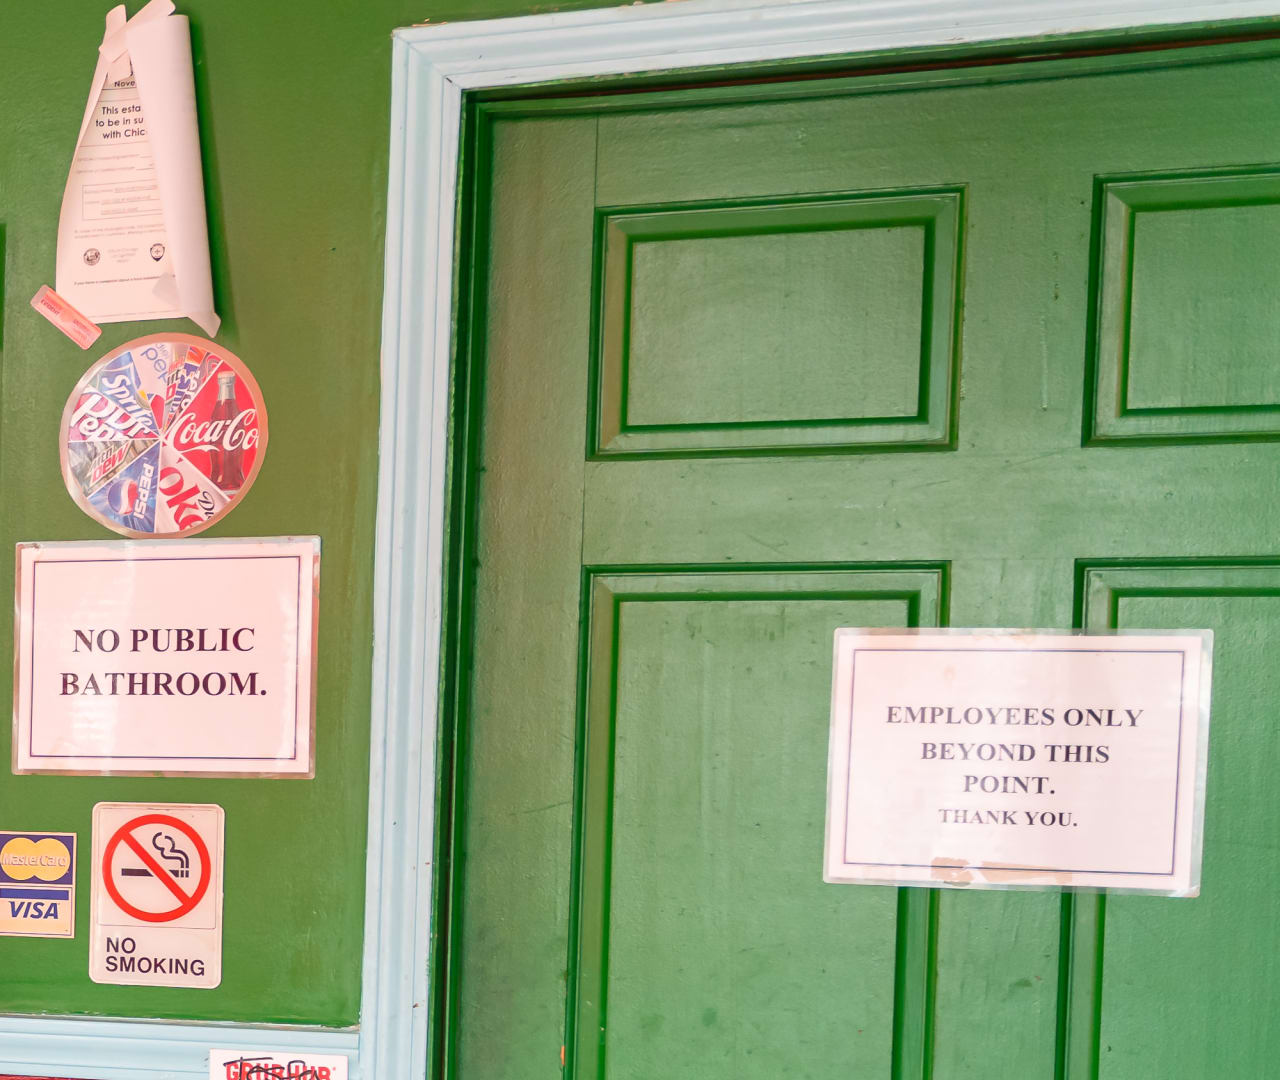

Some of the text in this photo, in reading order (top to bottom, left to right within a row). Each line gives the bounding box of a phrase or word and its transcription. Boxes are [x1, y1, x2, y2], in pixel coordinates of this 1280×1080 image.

[102, 107, 118, 115] This
[96, 119, 105, 127] to
[123, 117, 130, 125] in
[103, 128, 148, 139] with Chic
[102, 375, 155, 431] Sprite
[165, 409, 259, 454] Coca-Co
[133, 463, 154, 519] PEPSI
[159, 467, 204, 530] oke
[73, 627, 256, 653] NO PUBLIC
[59, 671, 267, 697] BATHROOM.
[886, 706, 1144, 728] EMPLOYEES ONLY
[921, 742, 1110, 764] BEYOND THIS
[963, 774, 1056, 795] POINT.
[938, 808, 1078, 828] THANK YOU.
[1, 853, 68, 867] MasterCard
[9, 901, 60, 919] VISA
[106, 937, 137, 954] NO
[106, 956, 206, 977] SMOKING
